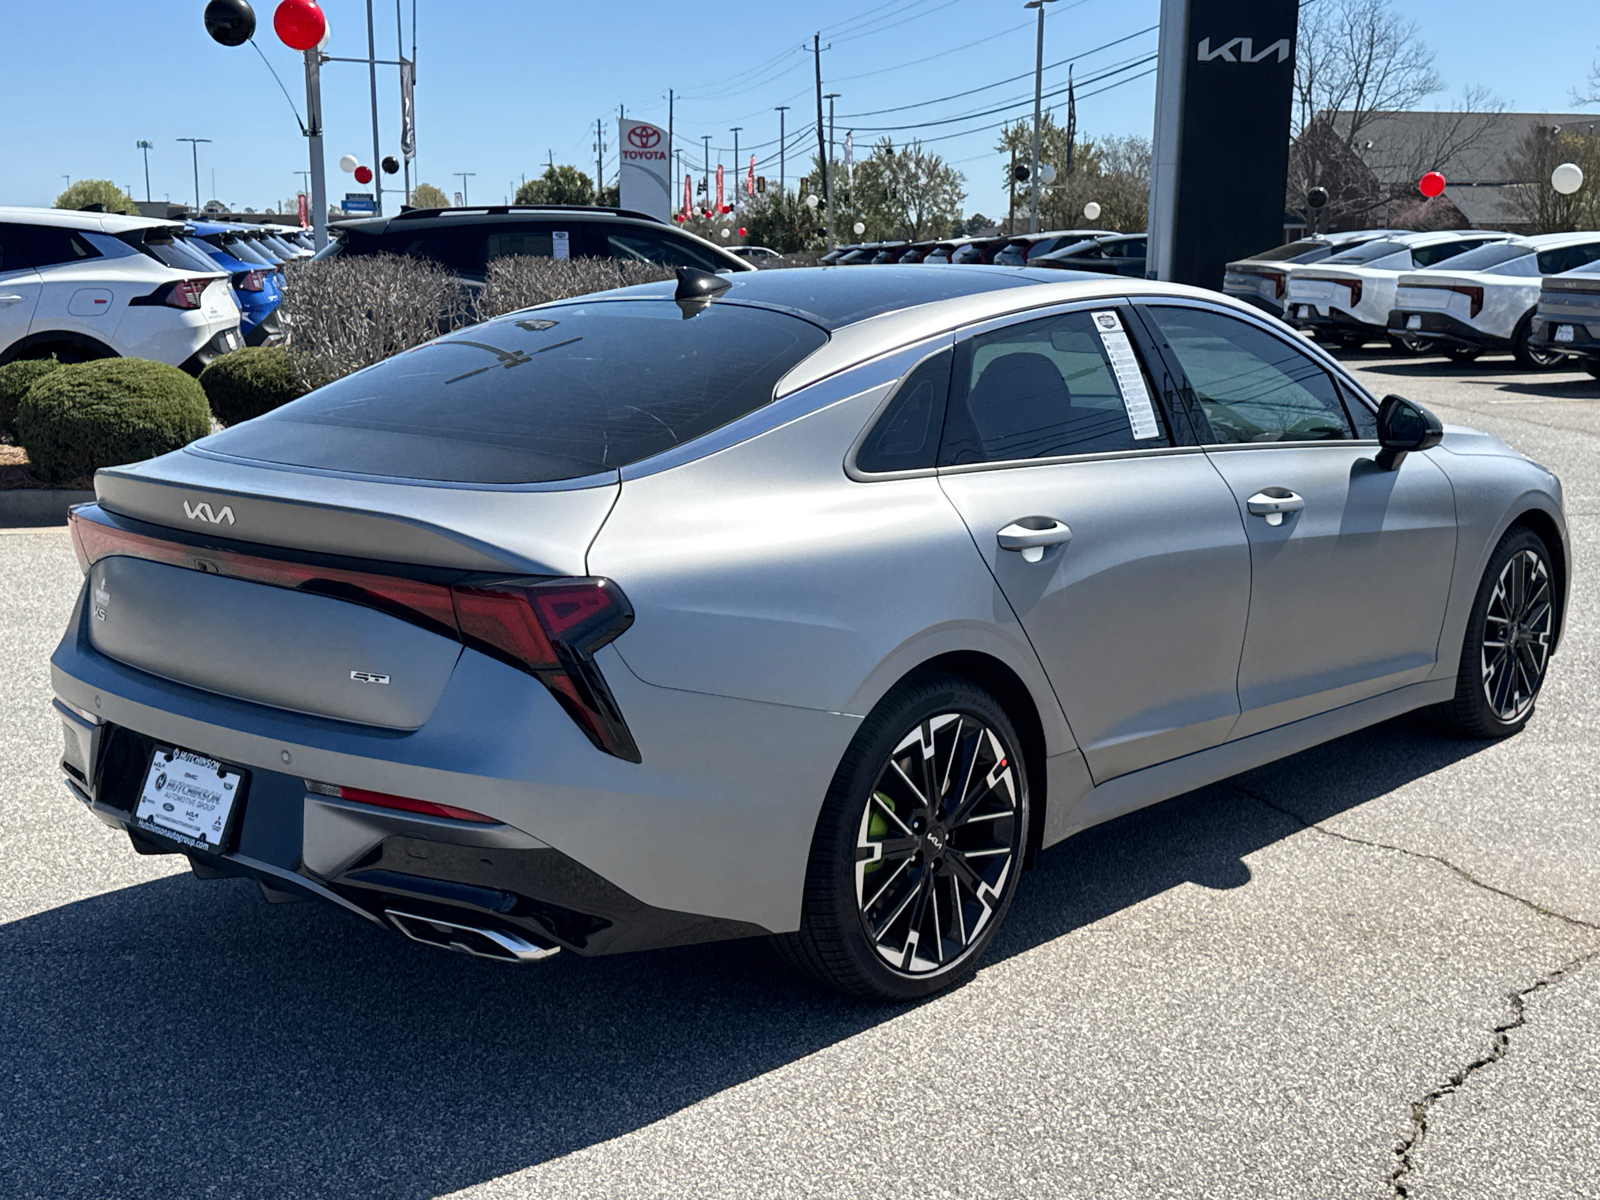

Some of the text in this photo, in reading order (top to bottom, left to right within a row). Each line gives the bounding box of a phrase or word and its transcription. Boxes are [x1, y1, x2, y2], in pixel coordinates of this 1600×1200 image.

[1197, 36, 1290, 64] KIA
[622, 150, 667, 160] TOYOTA
[183, 499, 236, 526] KIA
[180, 751, 221, 770] HUTCHINSON
[164, 791, 197, 807] AUTOMOTIVE
[196, 800, 216, 813] GROUP
[165, 781, 222, 805] HUTCHINSON
